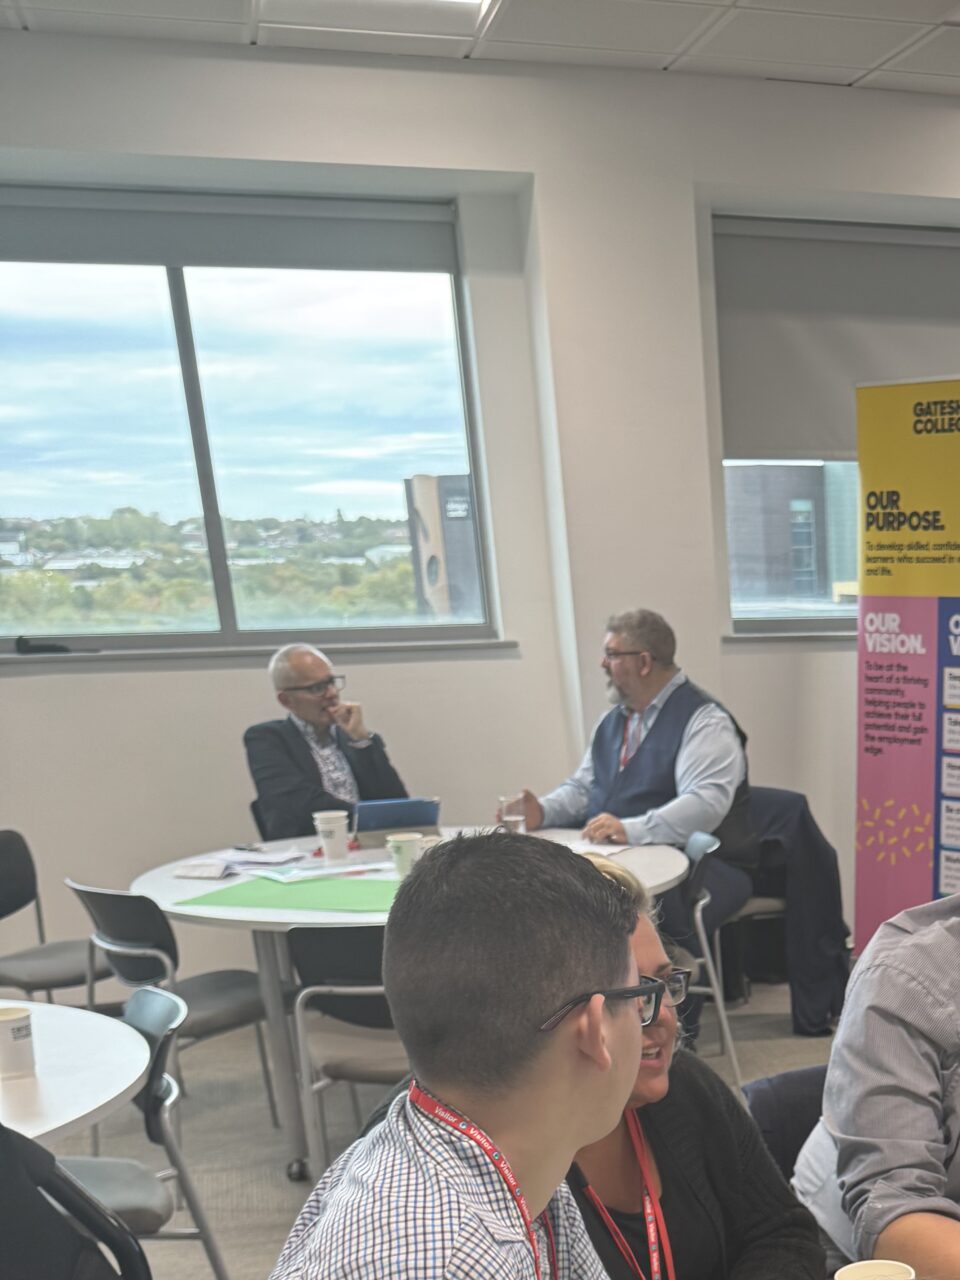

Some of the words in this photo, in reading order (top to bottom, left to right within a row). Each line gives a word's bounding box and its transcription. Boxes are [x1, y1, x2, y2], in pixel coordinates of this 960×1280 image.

[866, 491, 900, 510] OUR
[866, 511, 945, 531] PURPOSE.
[865, 613, 900, 632] OUR
[865, 633, 926, 654] VISION.
[434, 1106, 458, 1123] Visitor
[469, 1127, 493, 1151] Visitor
[500, 1161, 517, 1186] Visitor
